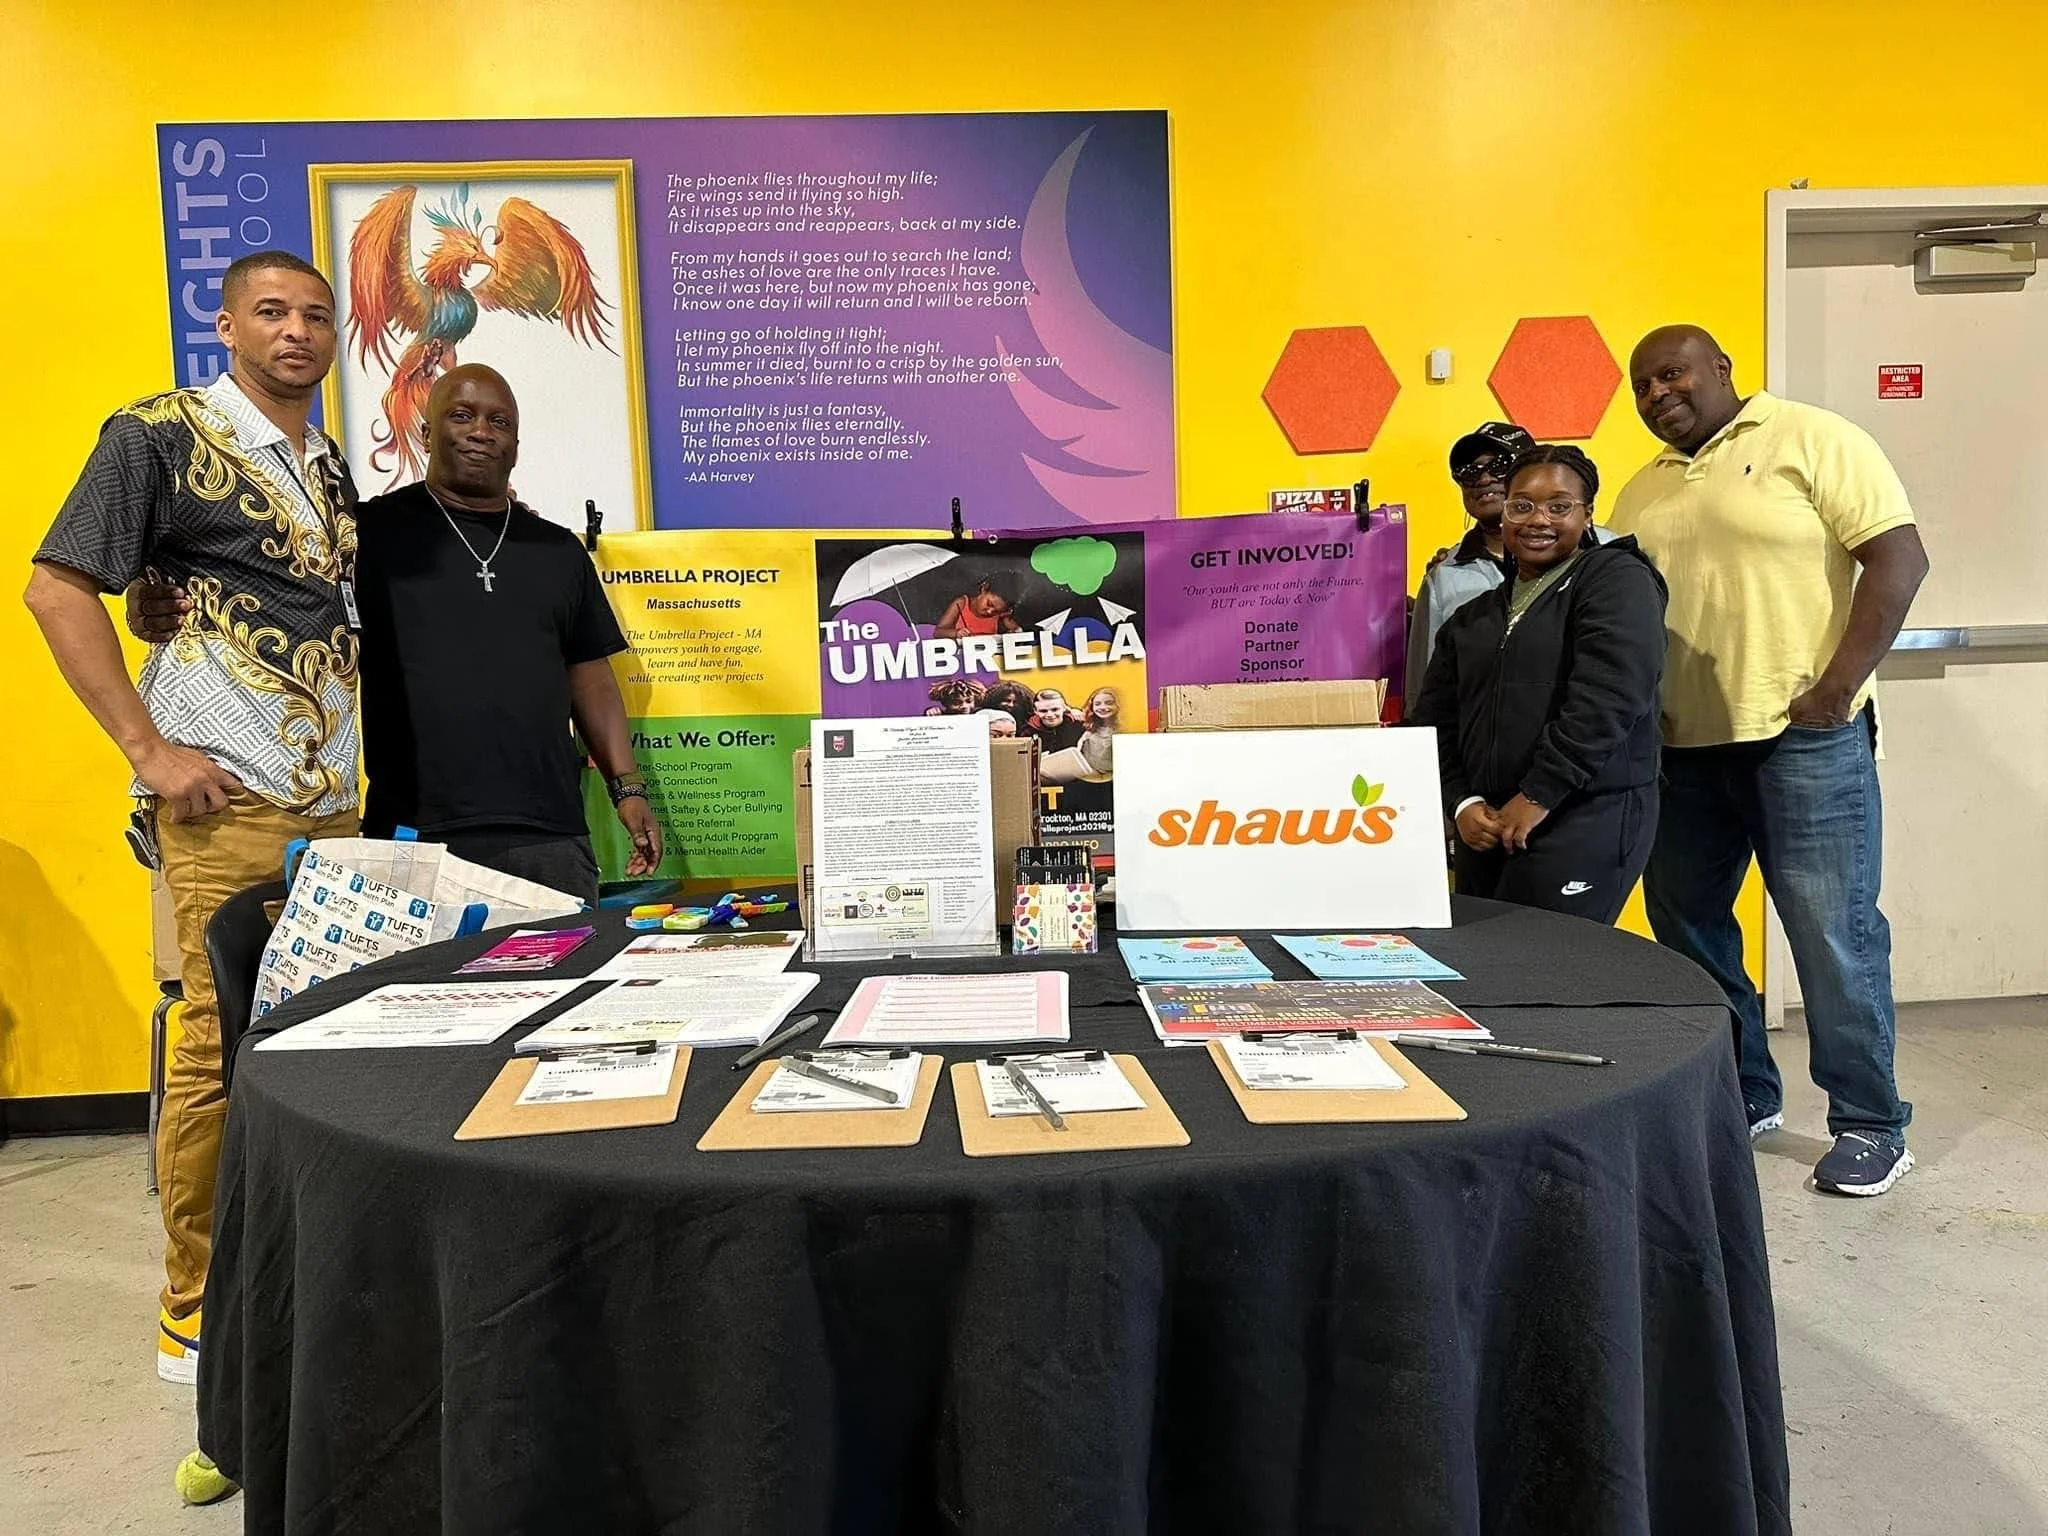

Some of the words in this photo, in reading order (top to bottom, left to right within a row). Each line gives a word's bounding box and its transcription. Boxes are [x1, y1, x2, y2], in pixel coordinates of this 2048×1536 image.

[668, 174, 692, 187] The
[696, 173, 759, 190] phoenix
[763, 173, 793, 186] flies
[797, 172, 880, 189] throughout
[884, 175, 905, 188] my
[910, 171, 937, 188] life;
[667, 189, 696, 202] Fire
[699, 188, 743, 205] wings
[747, 187, 784, 201] send
[788, 187, 797, 200] it
[801, 187, 842, 203] flying
[846, 190, 864, 200] so
[867, 186, 904, 203] high.
[668, 204, 687, 217] As
[691, 203, 700, 217] it
[704, 203, 738, 216] rises
[742, 206, 762, 219] up
[766, 203, 795, 216] into
[799, 202, 823, 216] the
[826, 202, 855, 218] sky,
[669, 220, 678, 233] It
[682, 219, 770, 236] disappears
[774, 218, 805, 232] and
[809, 220, 895, 234] reappears,
[899, 216, 937, 230] back
[940, 216, 956, 229] at
[960, 219, 981, 232] my
[985, 215, 1021, 229] side.
[1880, 367, 1921, 375] RESTRICTED
[679, 404, 764, 421] Immortality
[768, 403, 779, 416] is
[783, 403, 808, 419] just
[812, 406, 823, 416] a
[827, 402, 886, 419] fantasy,
[680, 419, 703, 433] But
[707, 419, 731, 432] the
[735, 418, 797, 435] phoenix
[801, 418, 830, 431] flies
[834, 417, 905, 434] eternally.
[683, 434, 707, 447] The
[711, 433, 760, 447] flames
[764, 433, 779, 446] of
[783, 433, 816, 446] love
[820, 432, 854, 445] burn
[857, 431, 931, 448] endlessly.
[683, 449, 704, 465] My
[709, 448, 770, 465] phoenix
[774, 447, 816, 461] exists
[819, 446, 864, 460] inside
[867, 446, 882, 459] of
[886, 449, 913, 459] me.
[684, 470, 707, 482] -AA
[710, 469, 754, 484] Harvey
[1276, 491, 1325, 505] PIZZA
[1190, 551, 1232, 568] GET
[1237, 541, 1354, 566] INVOLVED!
[602, 570, 696, 584] UMBRELLA
[702, 569, 780, 586] PROJECT
[1210, 582, 1240, 596] youth
[1242, 584, 1260, 594] are
[1262, 581, 1280, 592] not
[1282, 578, 1305, 592] only
[1308, 576, 1324, 588] the
[646, 598, 742, 610] Massachusetts
[1210, 598, 1237, 610] BUT
[1238, 599, 1257, 608] are
[1259, 594, 1290, 608] Today
[1294, 594, 1304, 604] &
[820, 620, 880, 643] The
[1244, 620, 1298, 634] Donate
[626, 630, 646, 641] The
[649, 629, 697, 641] Umbrella
[698, 628, 734, 643] Project
[744, 629, 762, 640] MA
[626, 644, 678, 656] empowers
[680, 643, 709, 655] youth
[710, 644, 722, 654] to
[723, 646, 762, 656] engage,
[828, 621, 1146, 684] UMBRELLA
[1244, 638, 1300, 652] Partner
[647, 658, 675, 668] learn
[676, 657, 698, 668] and
[699, 656, 724, 668] have
[723, 658, 744, 670] fun,
[1240, 657, 1304, 674] Sponsor
[628, 672, 656, 684] while
[658, 671, 701, 684] creating
[702, 674, 724, 682] new
[725, 672, 764, 684] projects
[678, 732, 711, 748] We
[718, 730, 776, 748] Offer:
[691, 762, 732, 773] Program
[664, 776, 718, 786] Connection
[668, 791, 676, 800] &
[677, 790, 721, 800] Wellness
[724, 789, 766, 801] Program
[672, 804, 700, 816] Saftey
[703, 804, 710, 813] &
[712, 804, 742, 816] Cyber
[745, 802, 783, 814] Bullying
[672, 818, 694, 828] Care
[697, 818, 736, 828] Referral
[1041, 813, 1074, 824] rockton,
[1075, 812, 1088, 822] MA
[1088, 811, 1112, 822] 02301
[1148, 800, 1399, 848] shaws
[664, 834, 672, 842] &
[674, 833, 702, 844] Young
[704, 832, 729, 842] Adult
[732, 832, 778, 844] Propgram
[665, 848, 673, 856] &
[674, 847, 706, 856] Mental
[708, 846, 738, 856] Health
[740, 846, 766, 856] Aider
[362, 890, 380, 903] ealth
[364, 878, 399, 900] TUFTS
[387, 916, 424, 939] TUFTS
[343, 930, 380, 952] TUFTS
[306, 941, 339, 964] TUFTS
